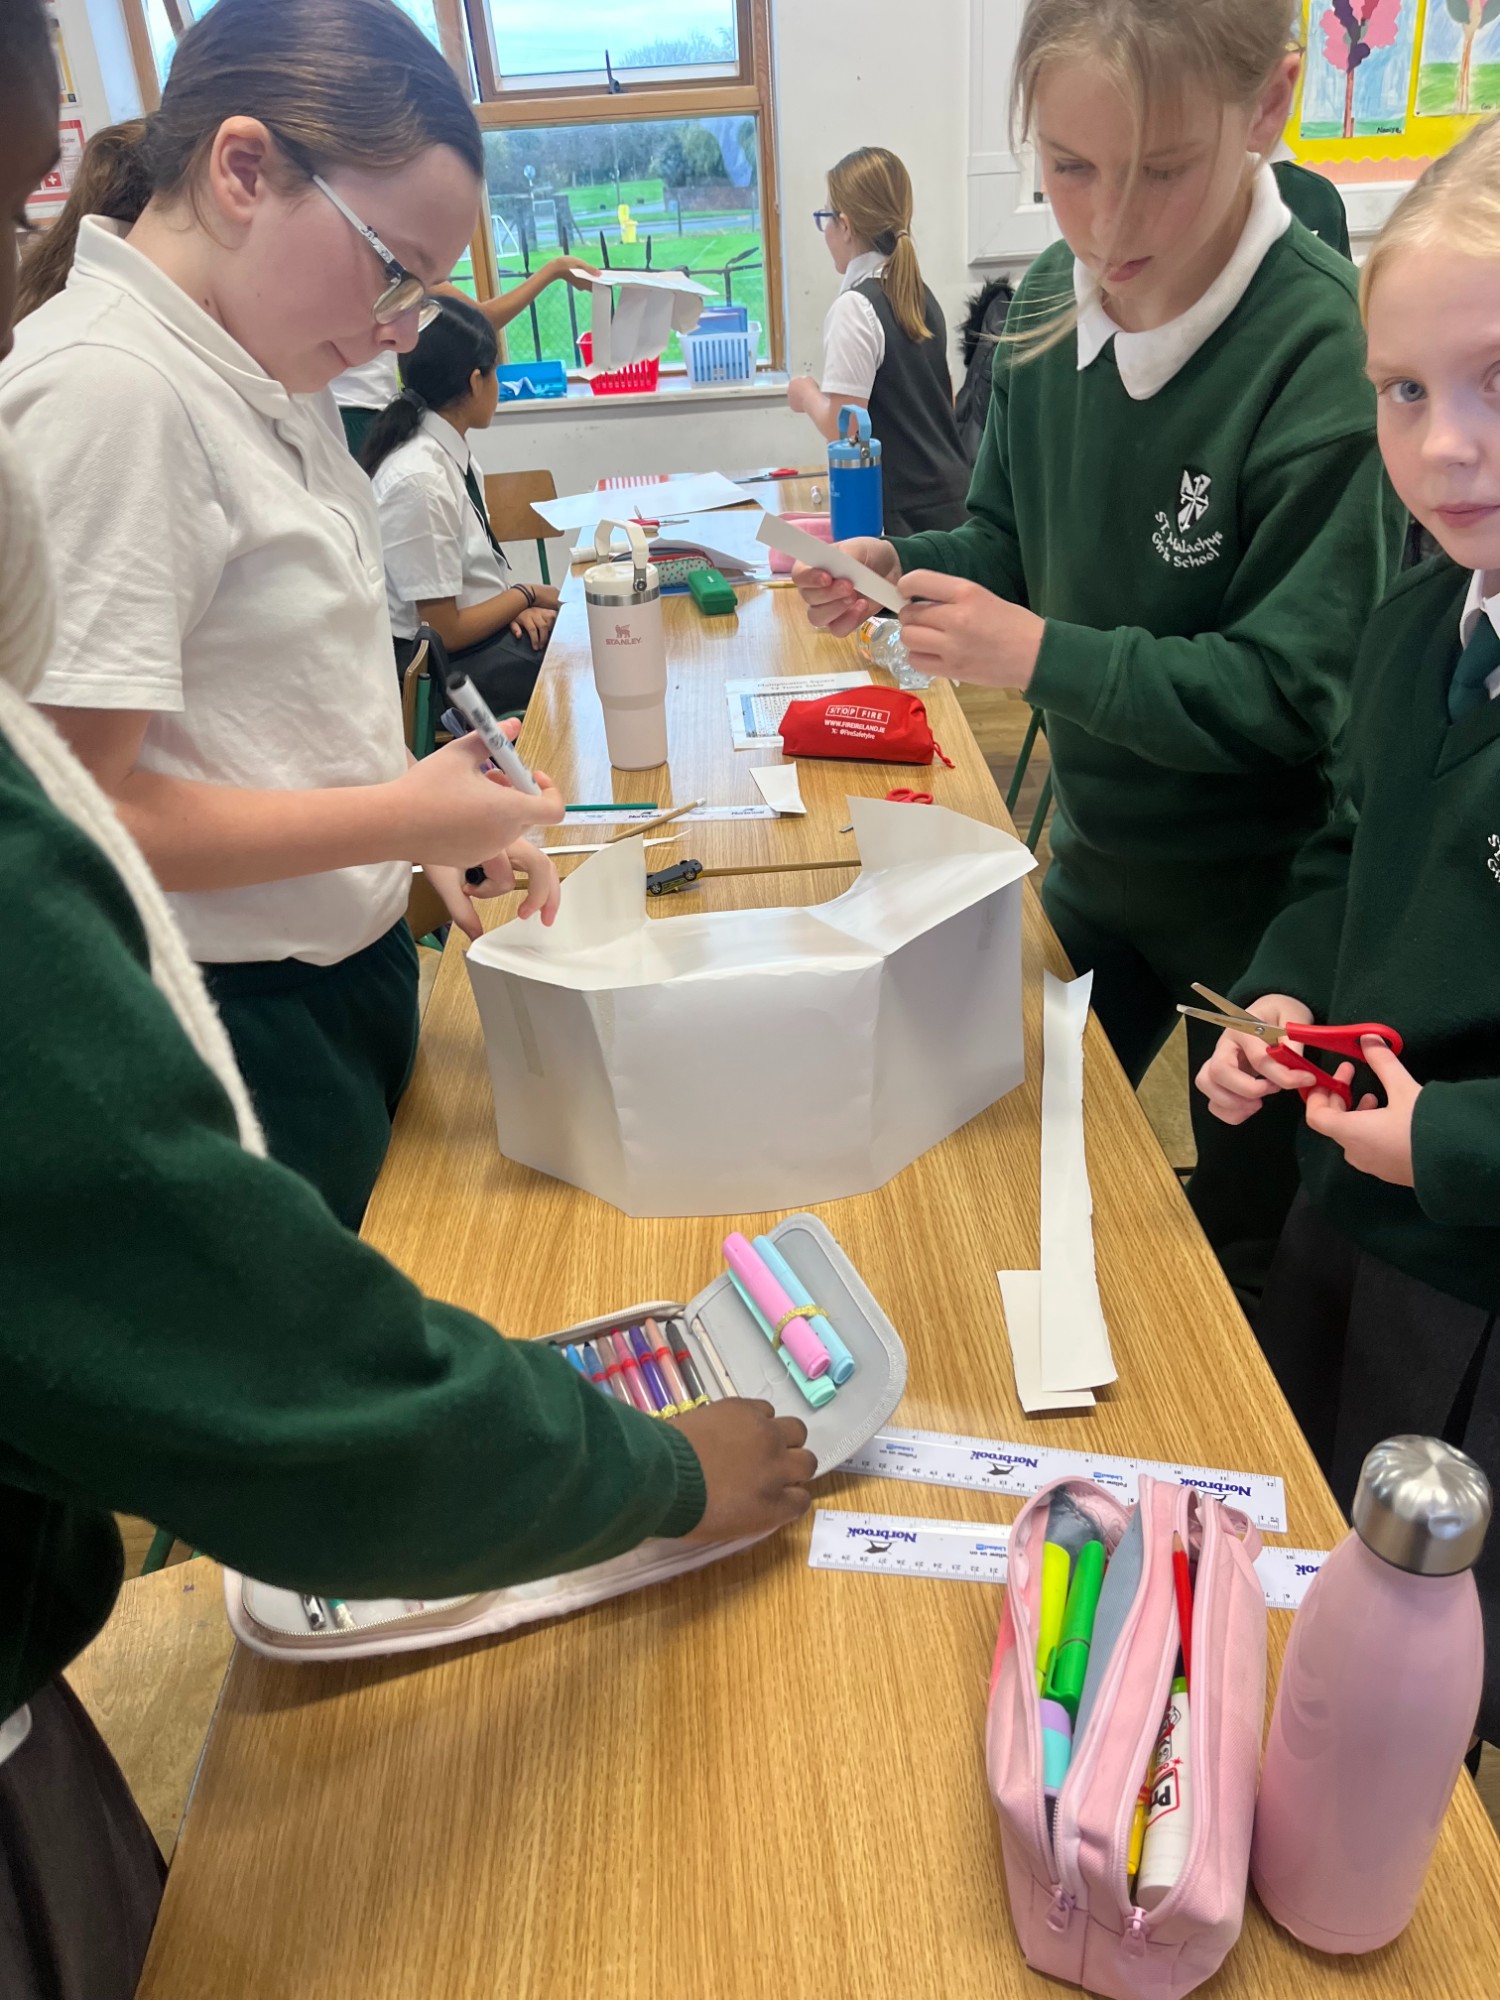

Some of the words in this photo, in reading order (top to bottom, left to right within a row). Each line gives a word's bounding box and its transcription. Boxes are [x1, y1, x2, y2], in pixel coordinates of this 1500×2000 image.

[1173, 547, 1220, 568] School
[606, 638, 642, 646] STANLEY
[830, 706, 856, 715] STOP
[862, 710, 882, 720] FIRE
[824, 720, 886, 734] WWW.FIREIRELAND.IE
[971, 1450, 1039, 1468] Norbrook
[1180, 1478, 1252, 1496] Norbrook
[848, 1527, 917, 1542] Norbrook
